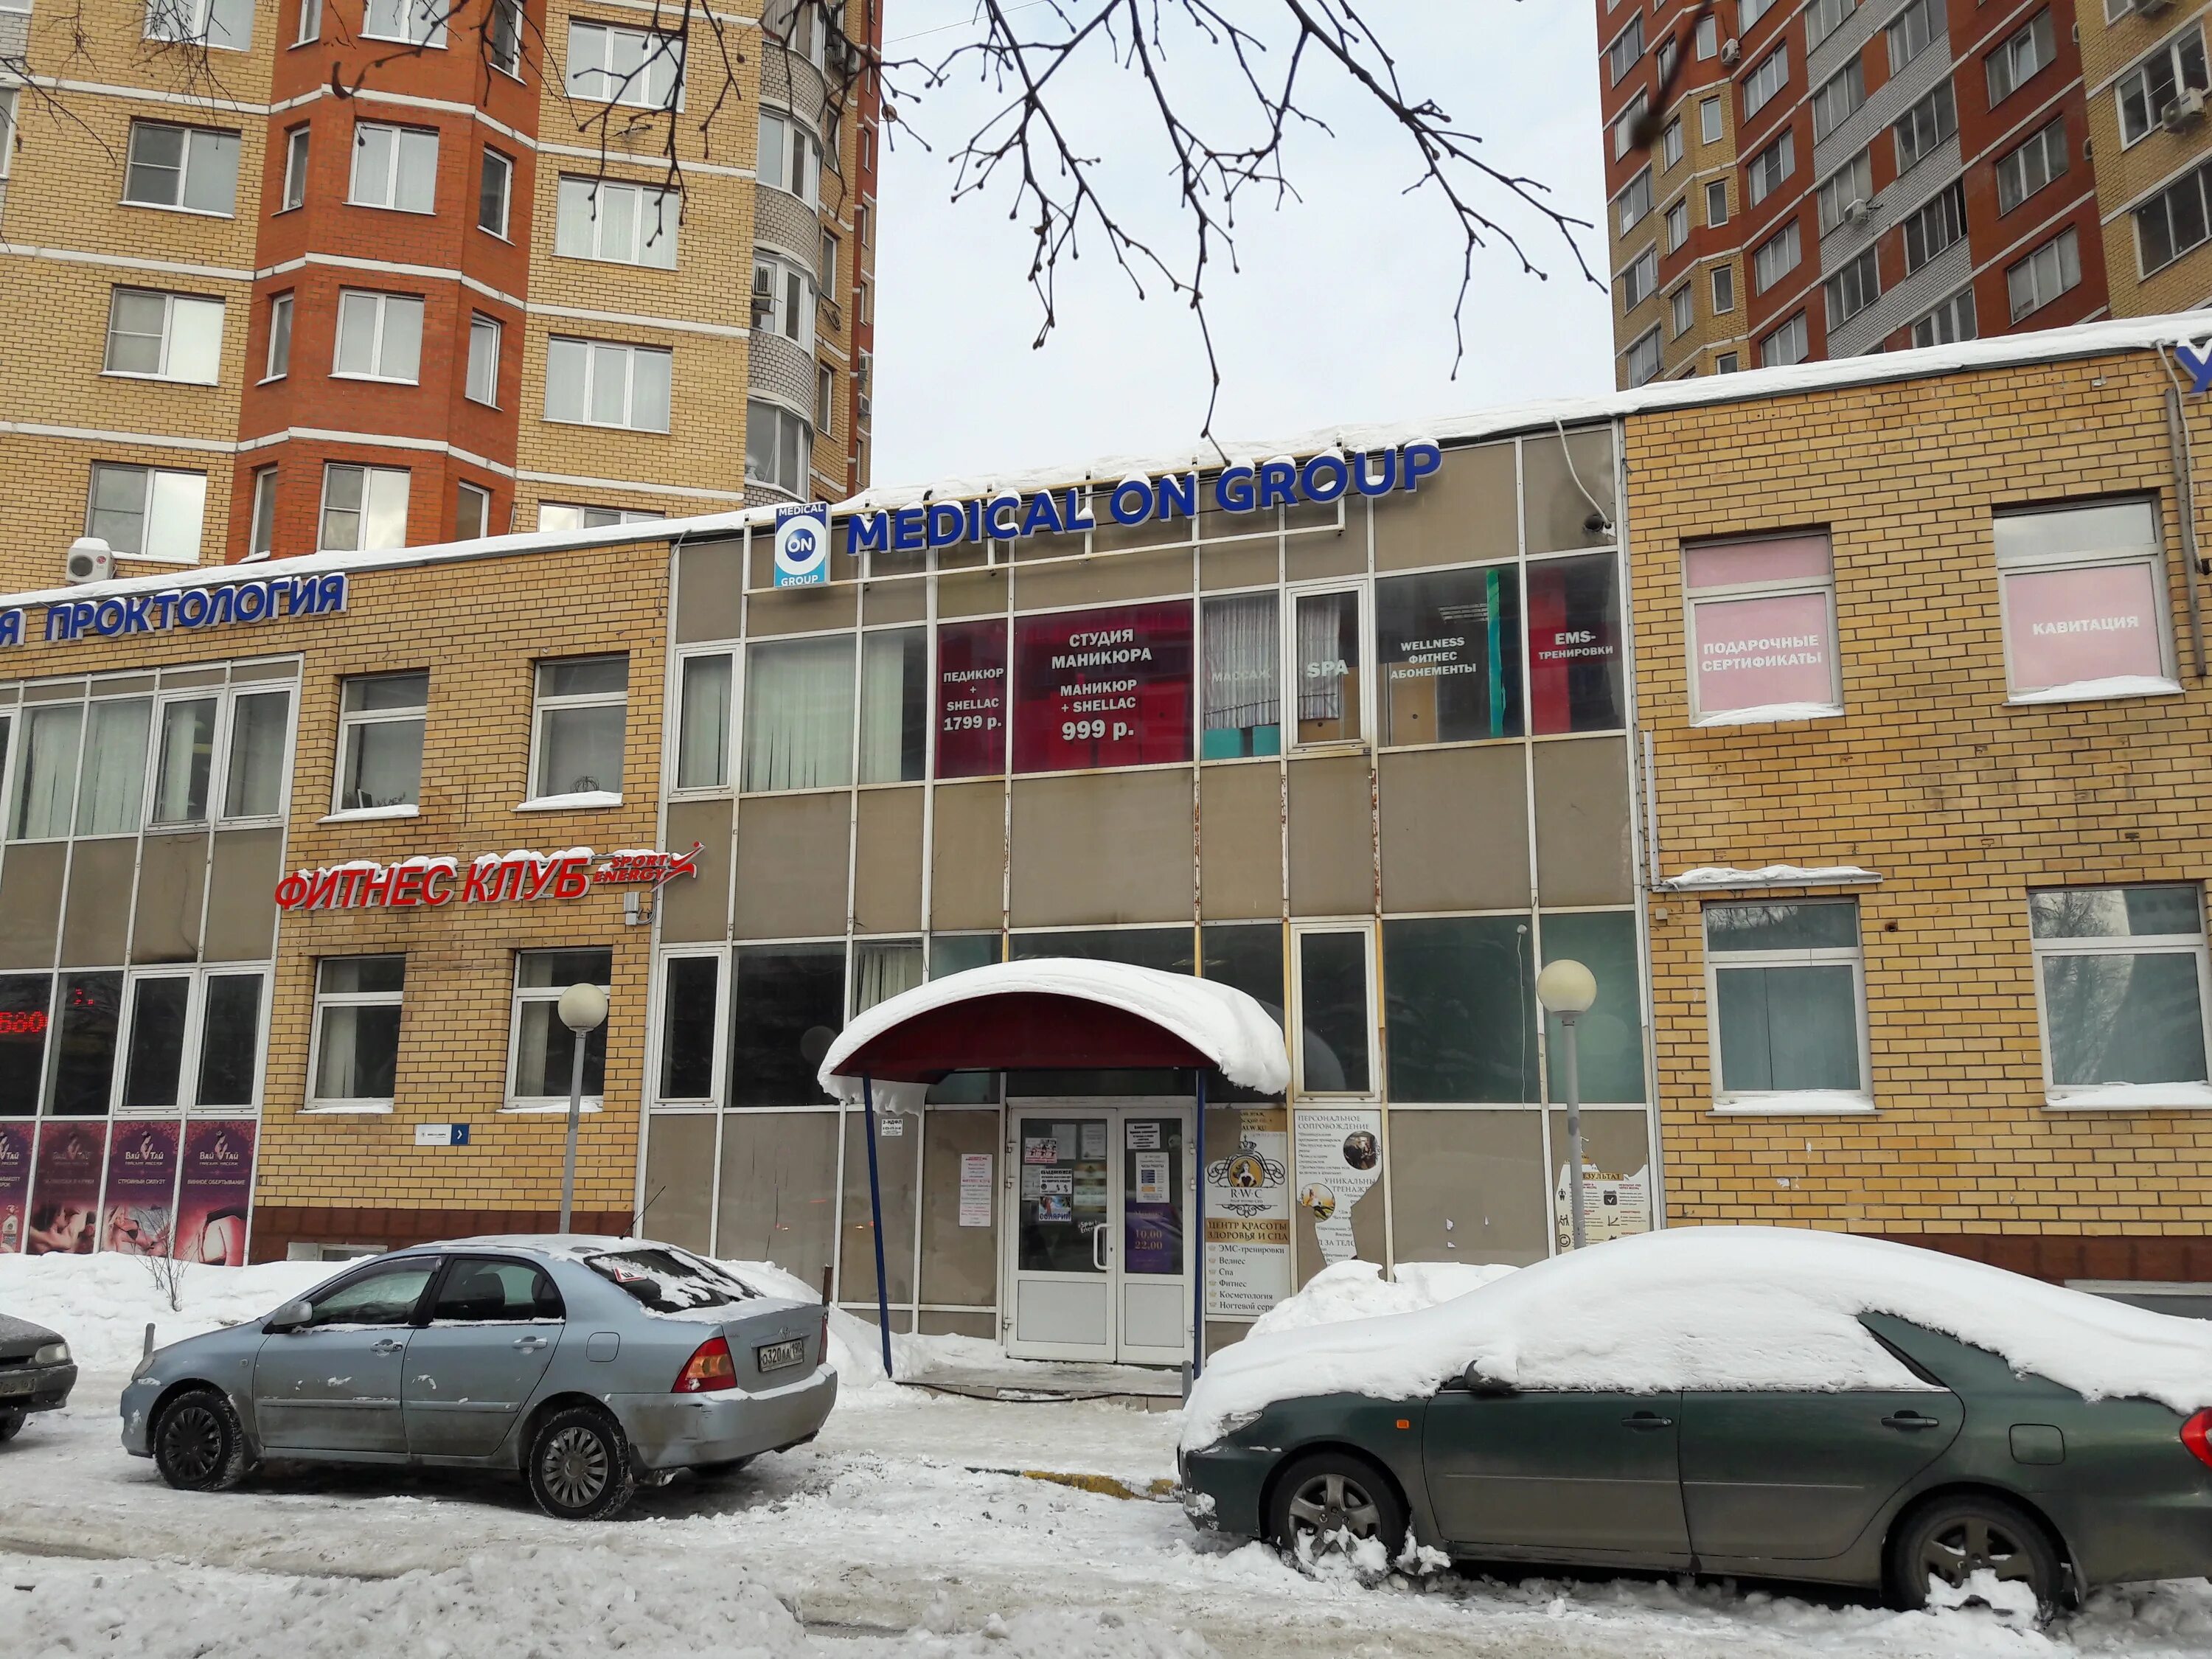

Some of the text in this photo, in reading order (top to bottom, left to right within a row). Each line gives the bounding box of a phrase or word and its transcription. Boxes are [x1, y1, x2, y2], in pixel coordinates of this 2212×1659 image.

[846, 442, 1441, 557] MEDICAL ON GROUP
[779, 504, 824, 516] MEDICAL
[787, 538, 812, 552] ON
[782, 575, 818, 586] GROUP
[46, 572, 346, 643] ПРОКТОЛОГИЯ
[2033, 616, 2138, 635] КАВИТАЦИЯ
[1069, 629, 1133, 647] СТУДИЯ
[1401, 637, 1464, 651] WELLNESS
[1555, 630, 1596, 645] EMS-
[1704, 636, 1819, 655] ПОДАРОЧНЫЕ
[1051, 648, 1152, 669] МАНИКЮРА
[1409, 652, 1457, 664] ФИТНЕС
[1539, 647, 1613, 660] ТРЕНИРОВКИ
[1307, 660, 1349, 678] SPA
[1702, 653, 1821, 672] СЕРТИФИКАТЫ
[944, 668, 1004, 684] ПЕДИКЮР
[1211, 669, 1270, 683] МАССАЖ
[1391, 664, 1476, 680] АБОНЕМЕНТЫ
[1060, 679, 1137, 696] МАНИКЮР
[947, 698, 999, 712] SHELLAC
[1073, 697, 1136, 712] SHELLAC
[944, 715, 982, 731] 1799
[1062, 720, 1105, 740] 999
[611, 855, 668, 868] SPORT
[593, 869, 667, 882] ENERGY
[275, 857, 590, 909] ФИТНЕС КЛУБ
[1208, 1221, 1287, 1231] ЦЕНТР КРАСОТЫ
[1208, 1231, 1254, 1240] ЗДОРОВЬЯ
[1219, 1245, 1284, 1255] ЭМС-тренировки
[1219, 1279, 1247, 1287] Фитнес
[1220, 1291, 1273, 1300] Косметология
[1220, 1301, 1255, 1310] Ногтевой
